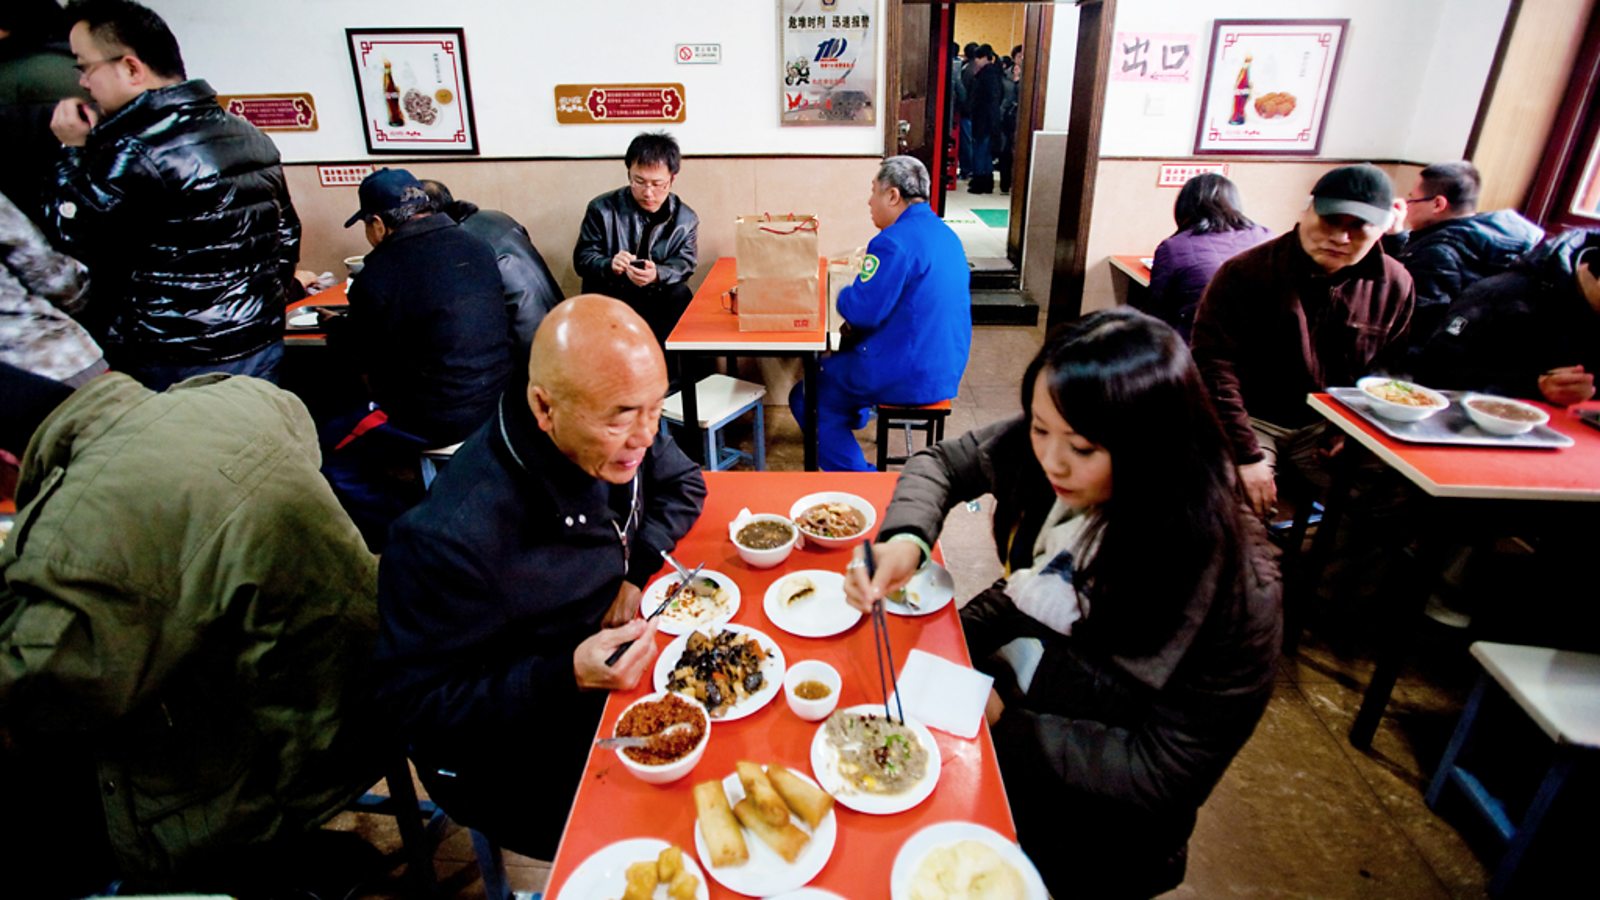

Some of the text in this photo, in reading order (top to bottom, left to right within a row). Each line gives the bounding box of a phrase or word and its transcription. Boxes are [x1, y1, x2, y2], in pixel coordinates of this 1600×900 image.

[788, 15, 869, 28] 危难时刻 迅速报警
[1122, 37, 1190, 77] 出口
